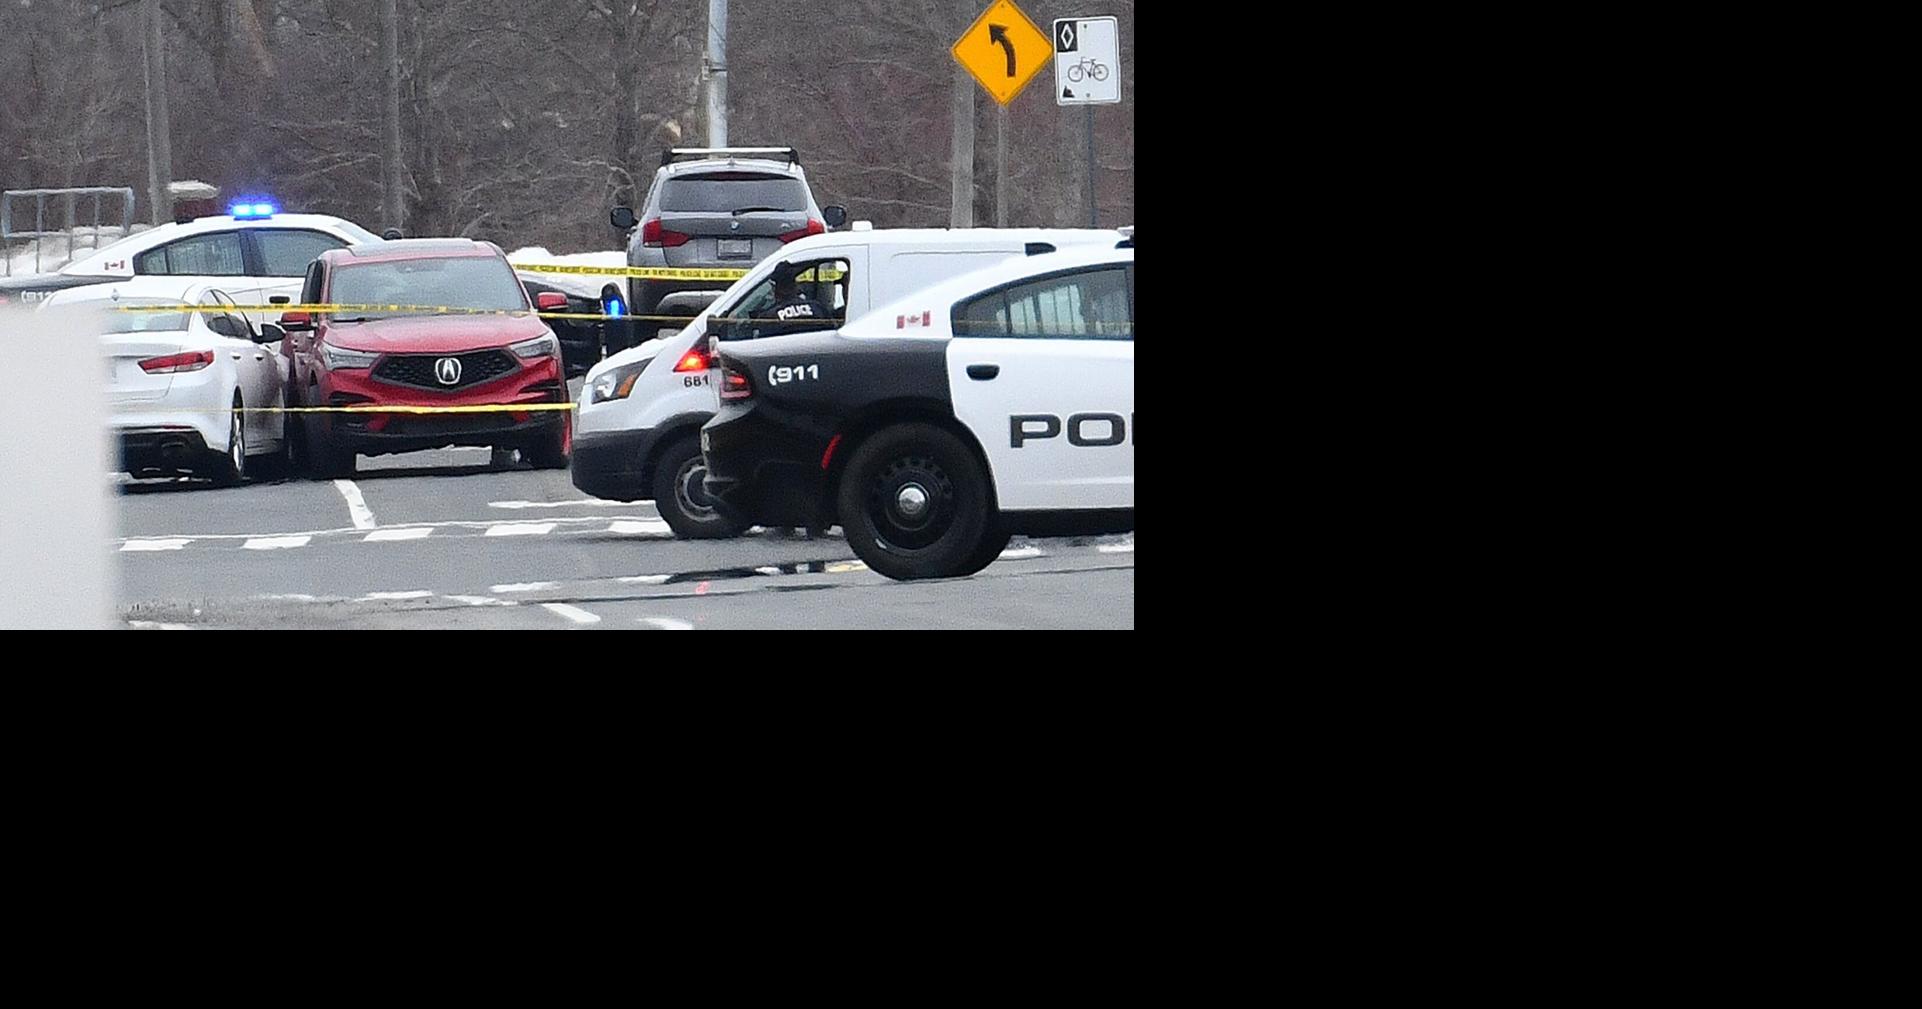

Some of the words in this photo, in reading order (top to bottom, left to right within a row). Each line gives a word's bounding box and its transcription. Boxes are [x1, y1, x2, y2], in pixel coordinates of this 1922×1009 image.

[777, 304, 813, 321] POLICE
[684, 375, 709, 388] 681
[1010, 412, 1134, 449] PO
